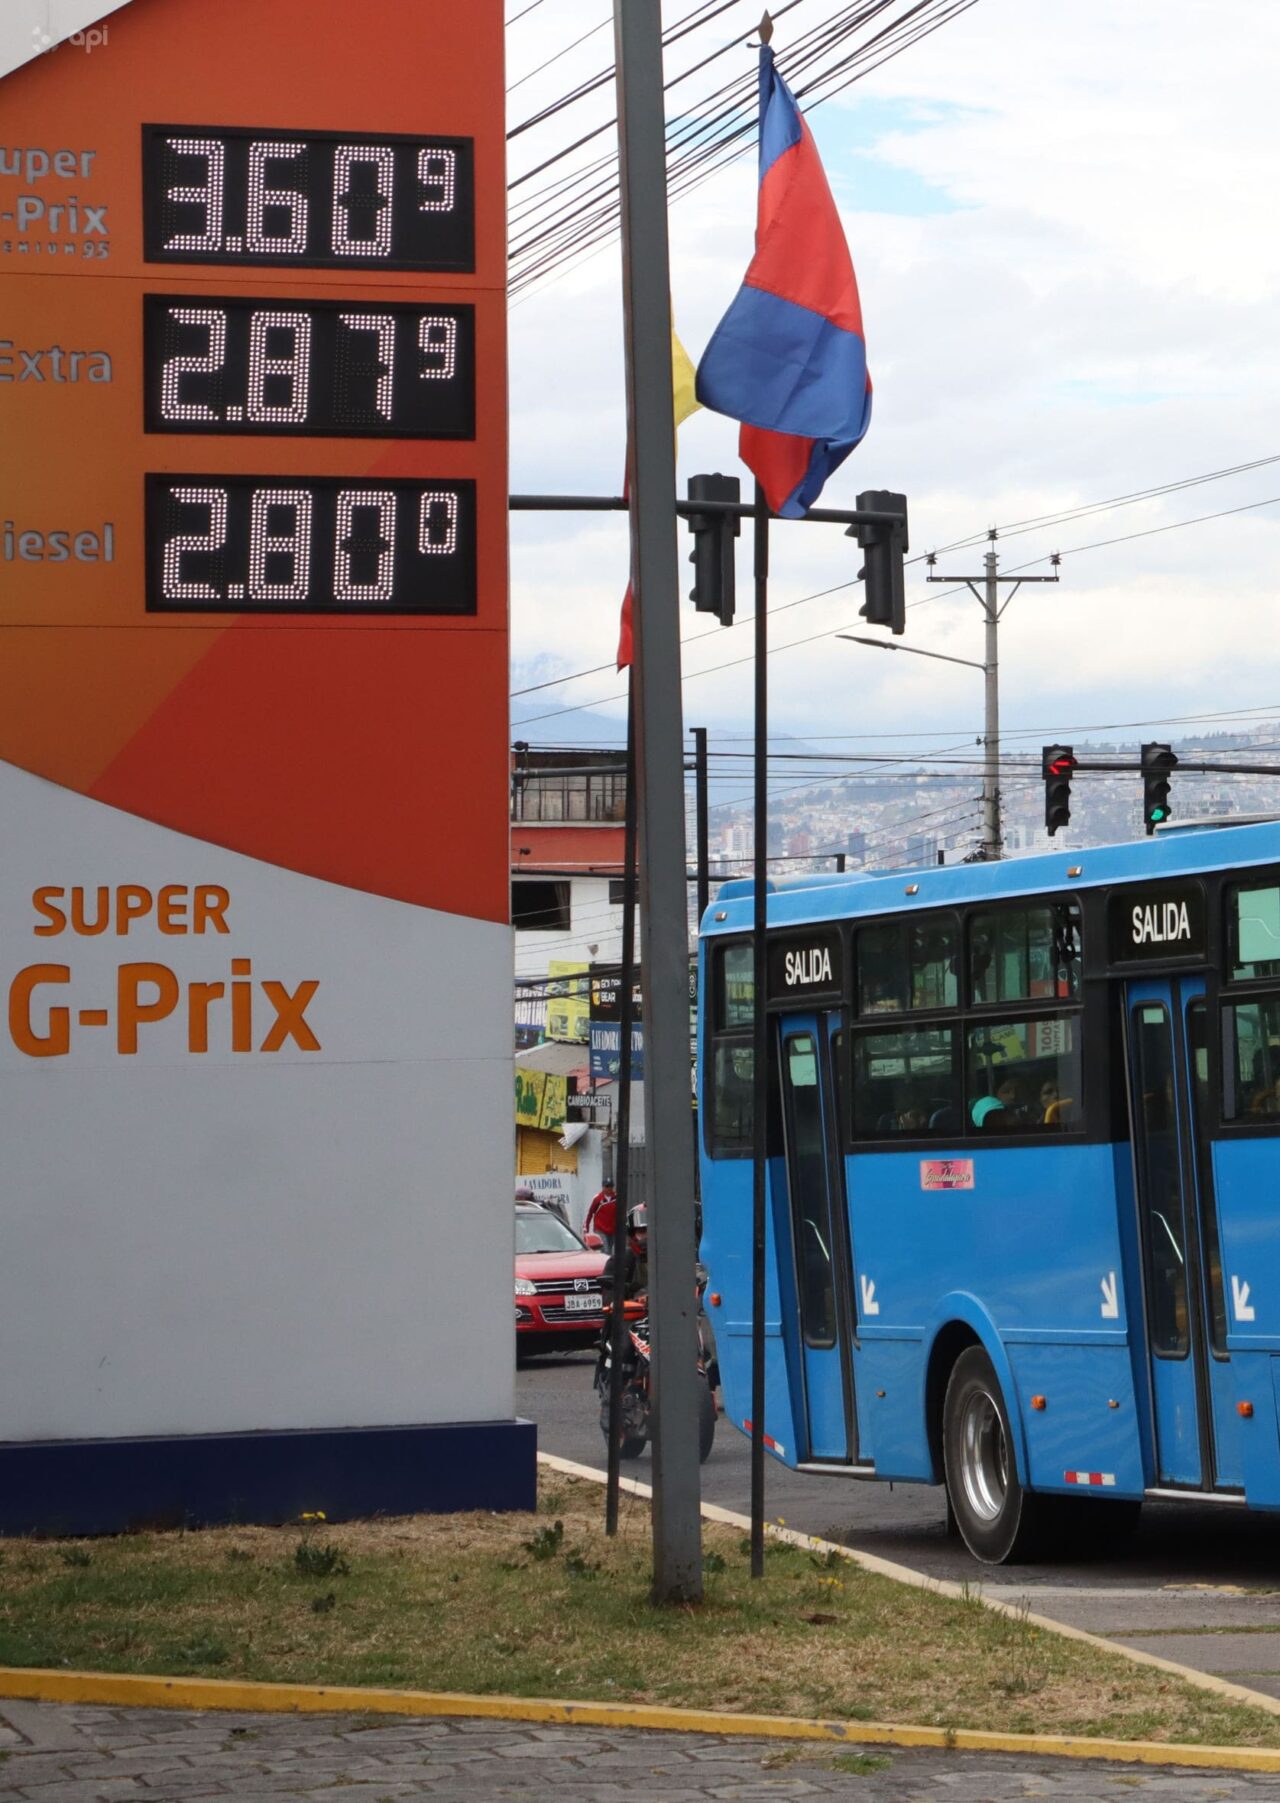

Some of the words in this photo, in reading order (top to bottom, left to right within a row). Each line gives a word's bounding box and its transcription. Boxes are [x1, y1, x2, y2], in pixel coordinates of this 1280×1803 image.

[82, 240, 110, 259] 95
[32, 884, 231, 936] SUPER
[1132, 901, 1191, 944] SALIDA
[785, 947, 832, 986] SALIDA
[8, 958, 322, 1057] G-Prix
